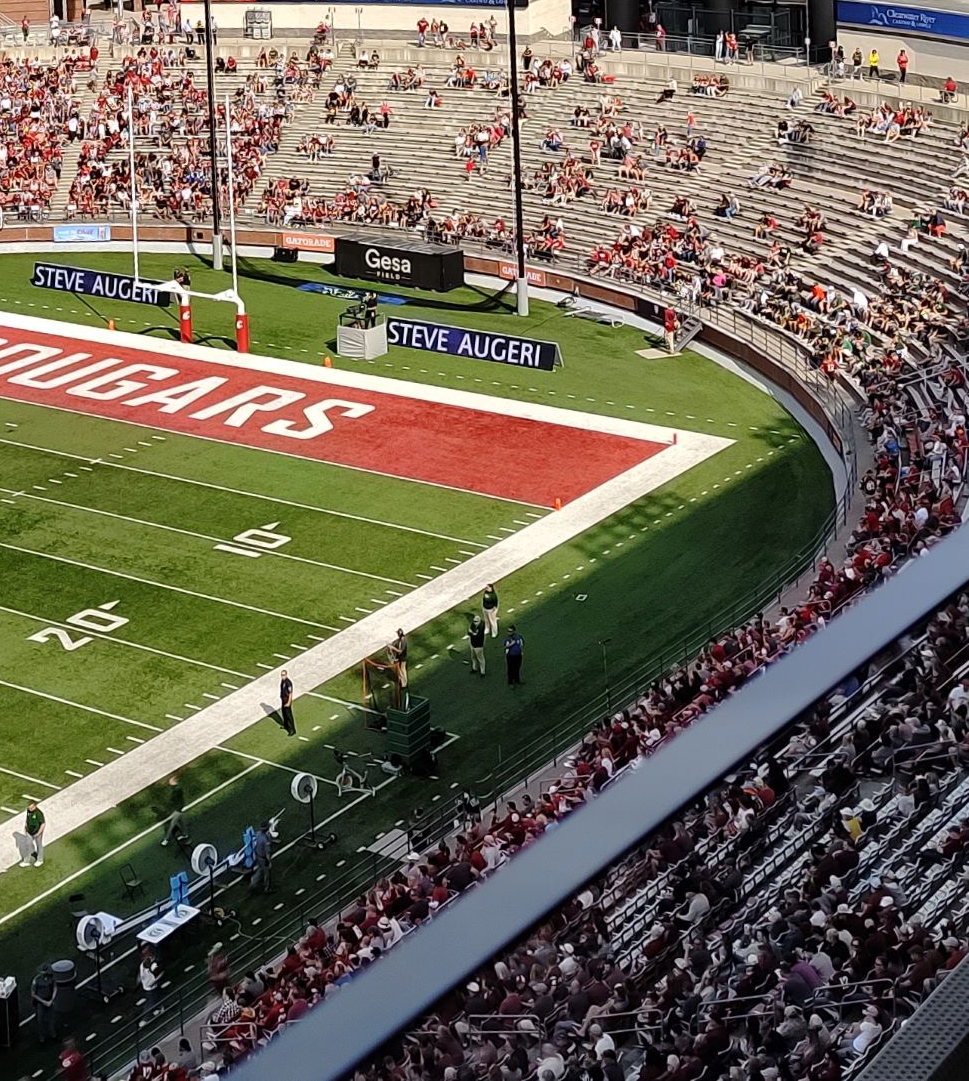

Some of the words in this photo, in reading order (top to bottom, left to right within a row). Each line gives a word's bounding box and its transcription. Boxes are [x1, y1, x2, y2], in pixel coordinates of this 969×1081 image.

[285, 236, 331, 248] GATORADE
[365, 248, 412, 274] Gesa
[34, 265, 86, 293] STEVE
[377, 271, 401, 280] FIELD
[388, 321, 450, 352] STEVE
[457, 333, 541, 367] AUGERI
[212, 528, 292, 558] 10
[26, 607, 130, 651] 20
